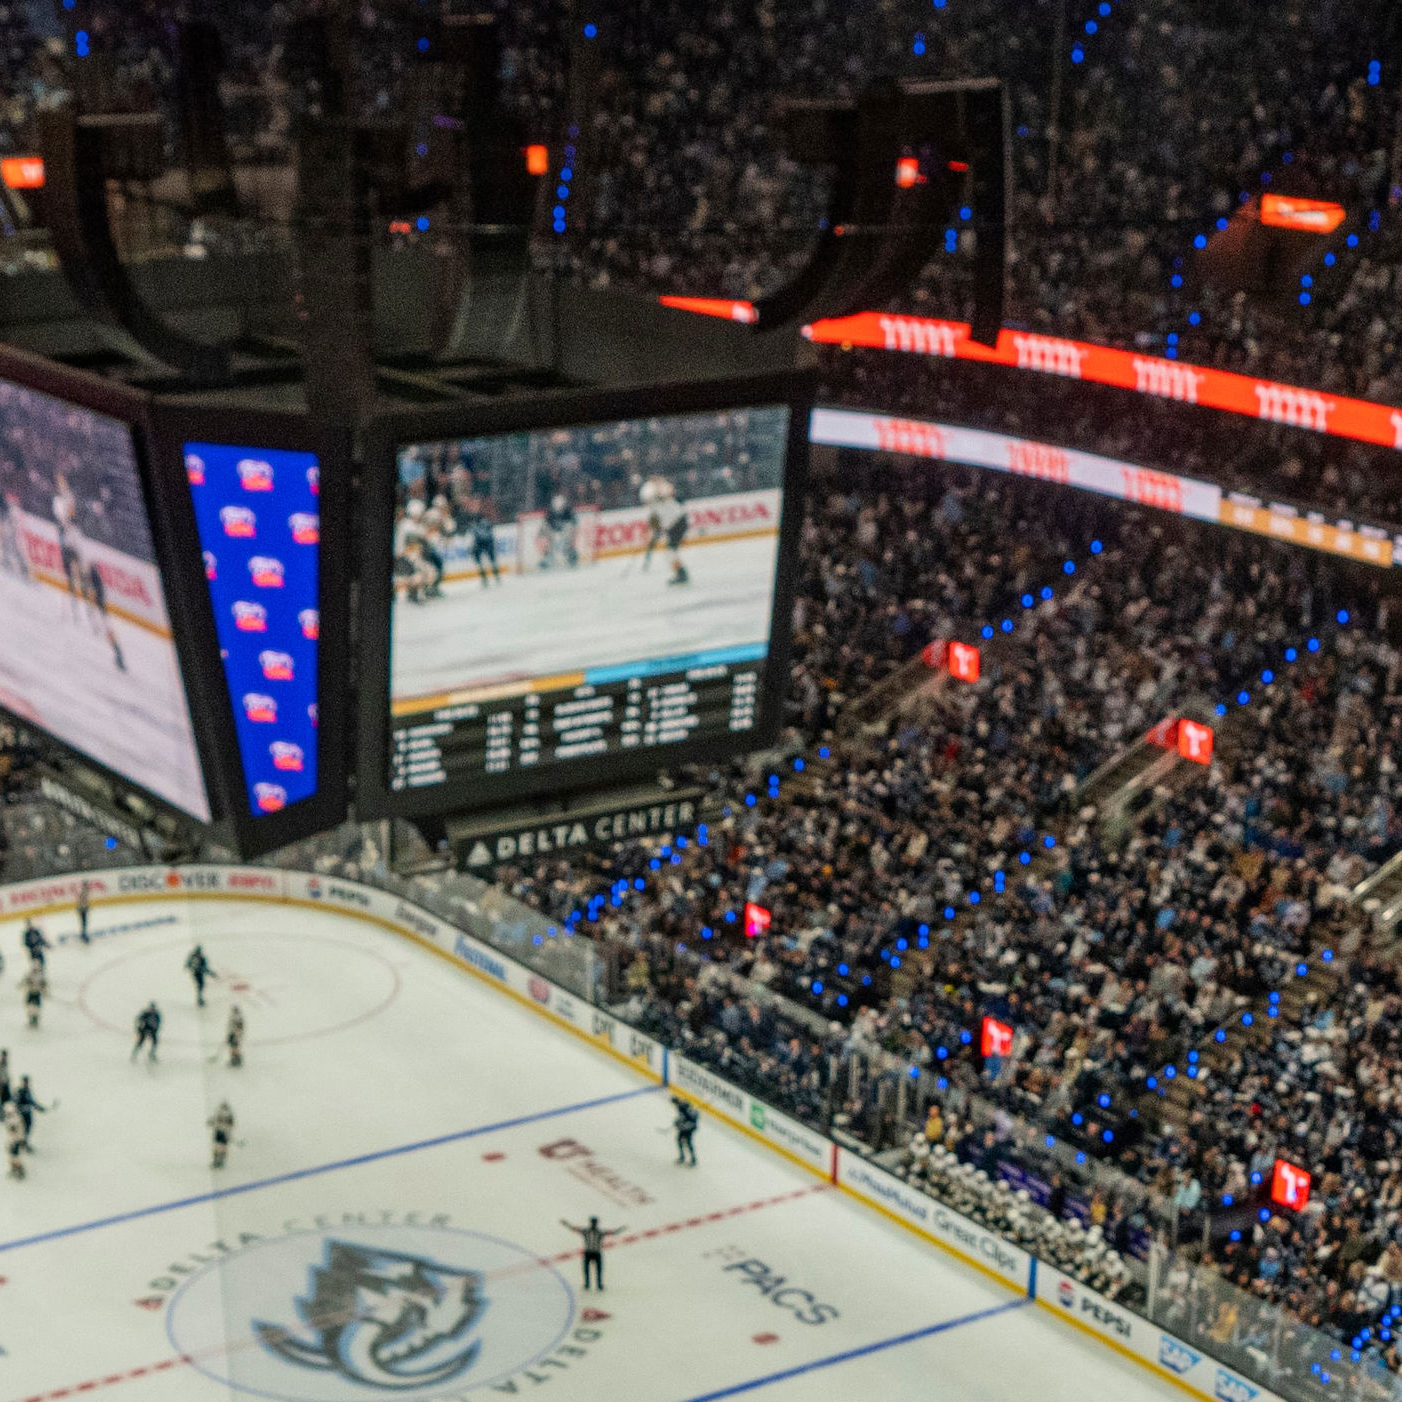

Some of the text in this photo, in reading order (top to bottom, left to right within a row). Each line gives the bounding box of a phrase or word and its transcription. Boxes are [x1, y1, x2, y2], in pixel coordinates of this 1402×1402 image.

[497, 801, 695, 859] DELTA CENTER
[118, 872, 220, 891] DISCOVER
[228, 874, 276, 889] ESPN
[151, 1209, 453, 1293] DELTA CENTER
[934, 1208, 1017, 1271] Great Clips
[722, 1257, 841, 1327] PACS
[1080, 1297, 1131, 1338] PEPSI
[493, 1328, 604, 1398] DELTA
